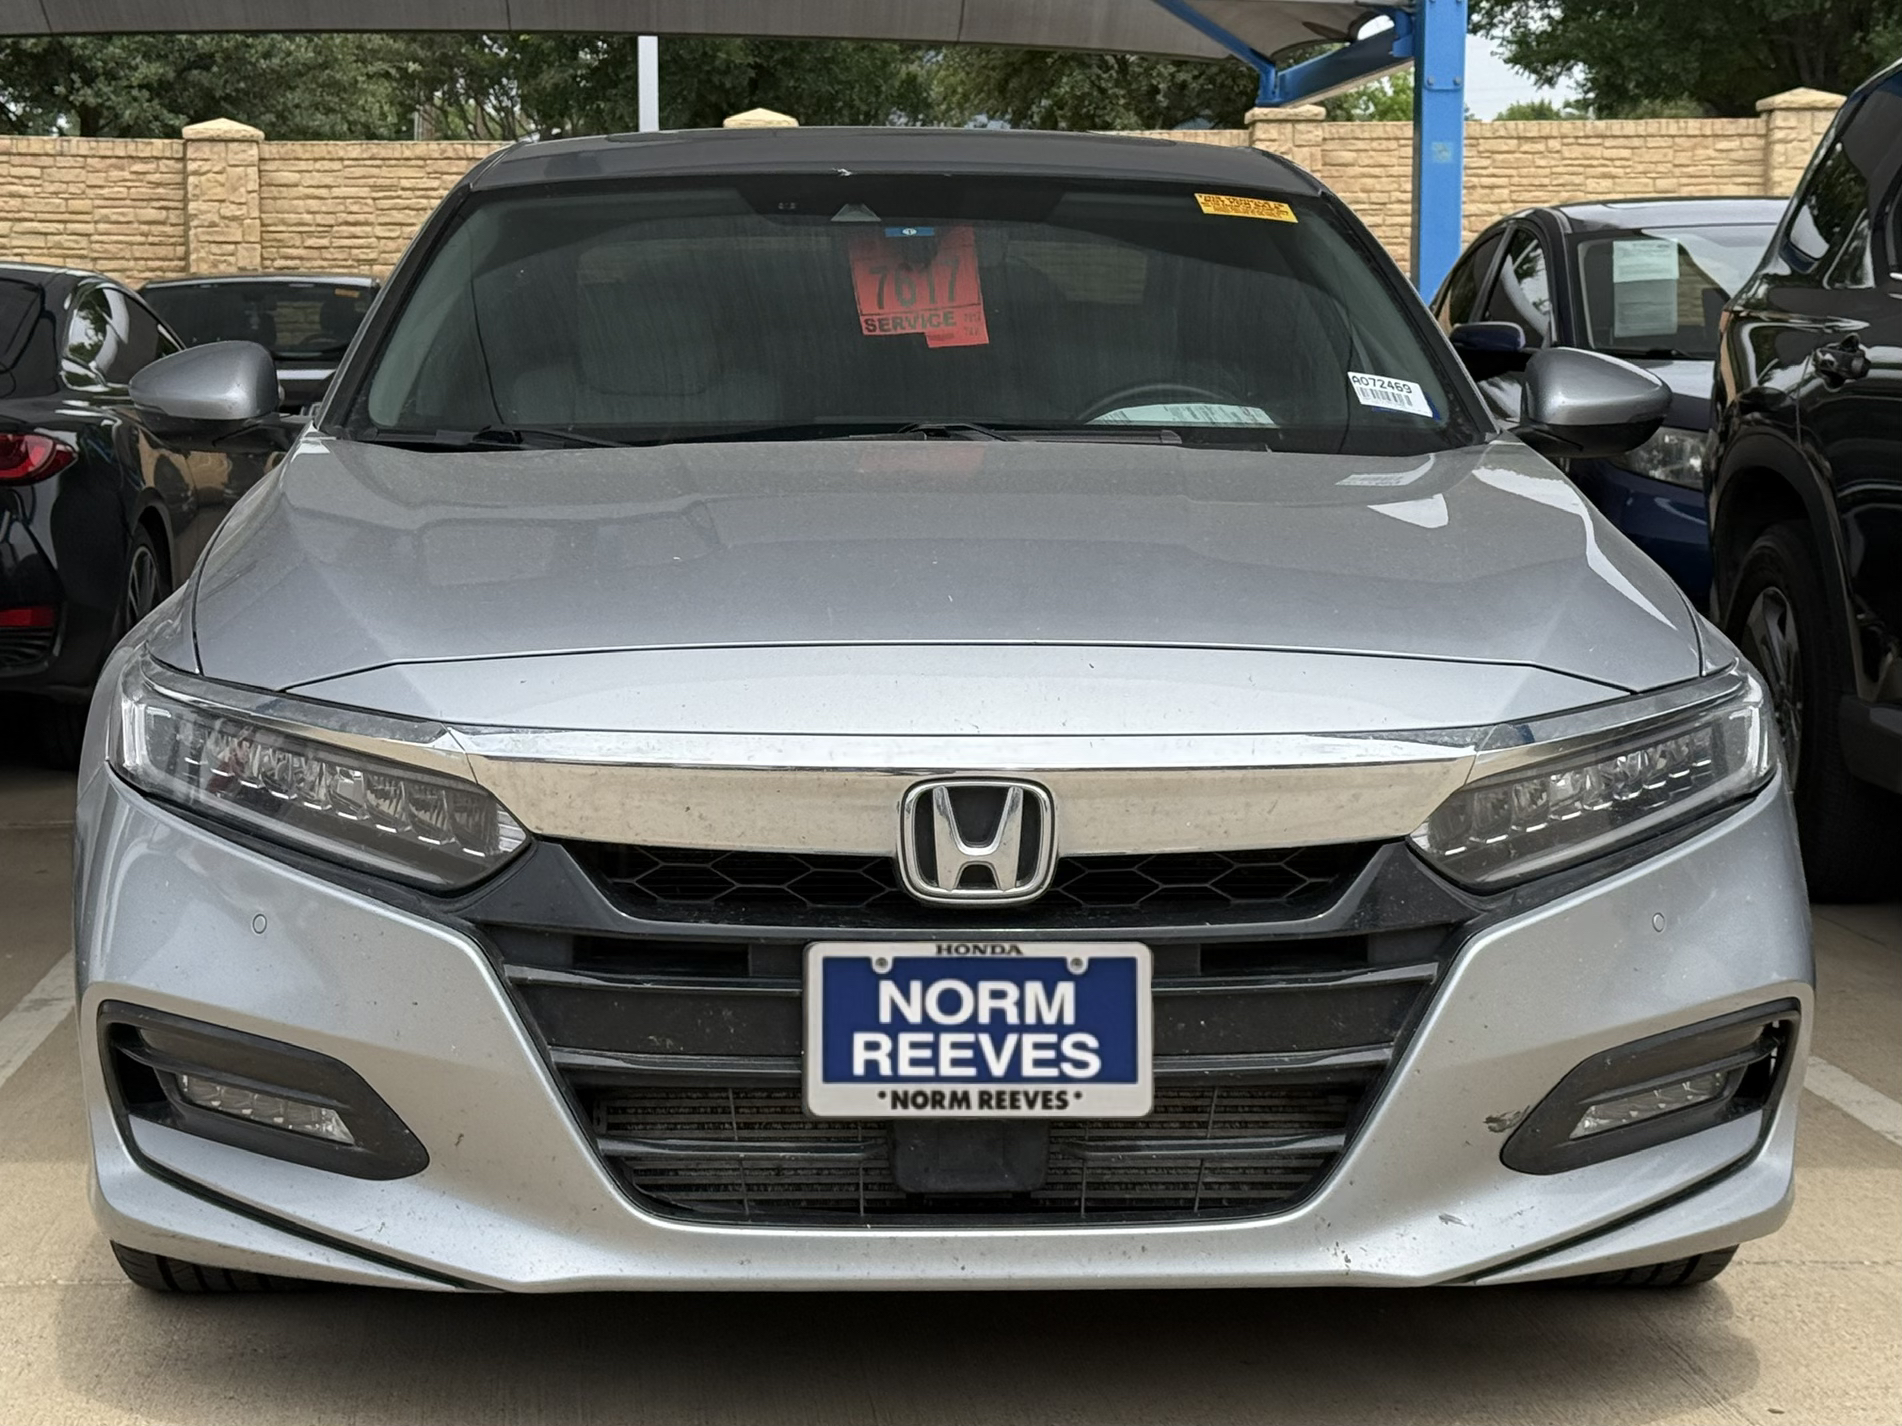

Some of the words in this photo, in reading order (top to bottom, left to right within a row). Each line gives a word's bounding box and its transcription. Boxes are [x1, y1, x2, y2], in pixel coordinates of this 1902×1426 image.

[863, 310, 957, 333] SERVICE
[1351, 375, 1412, 394] A072469
[935, 943, 1024, 956] HONDA
[879, 978, 1076, 1026] NORM
[852, 1032, 1102, 1079] REEVES
[890, 1090, 972, 1110] NORM
[978, 1090, 1070, 1111] REEVES
